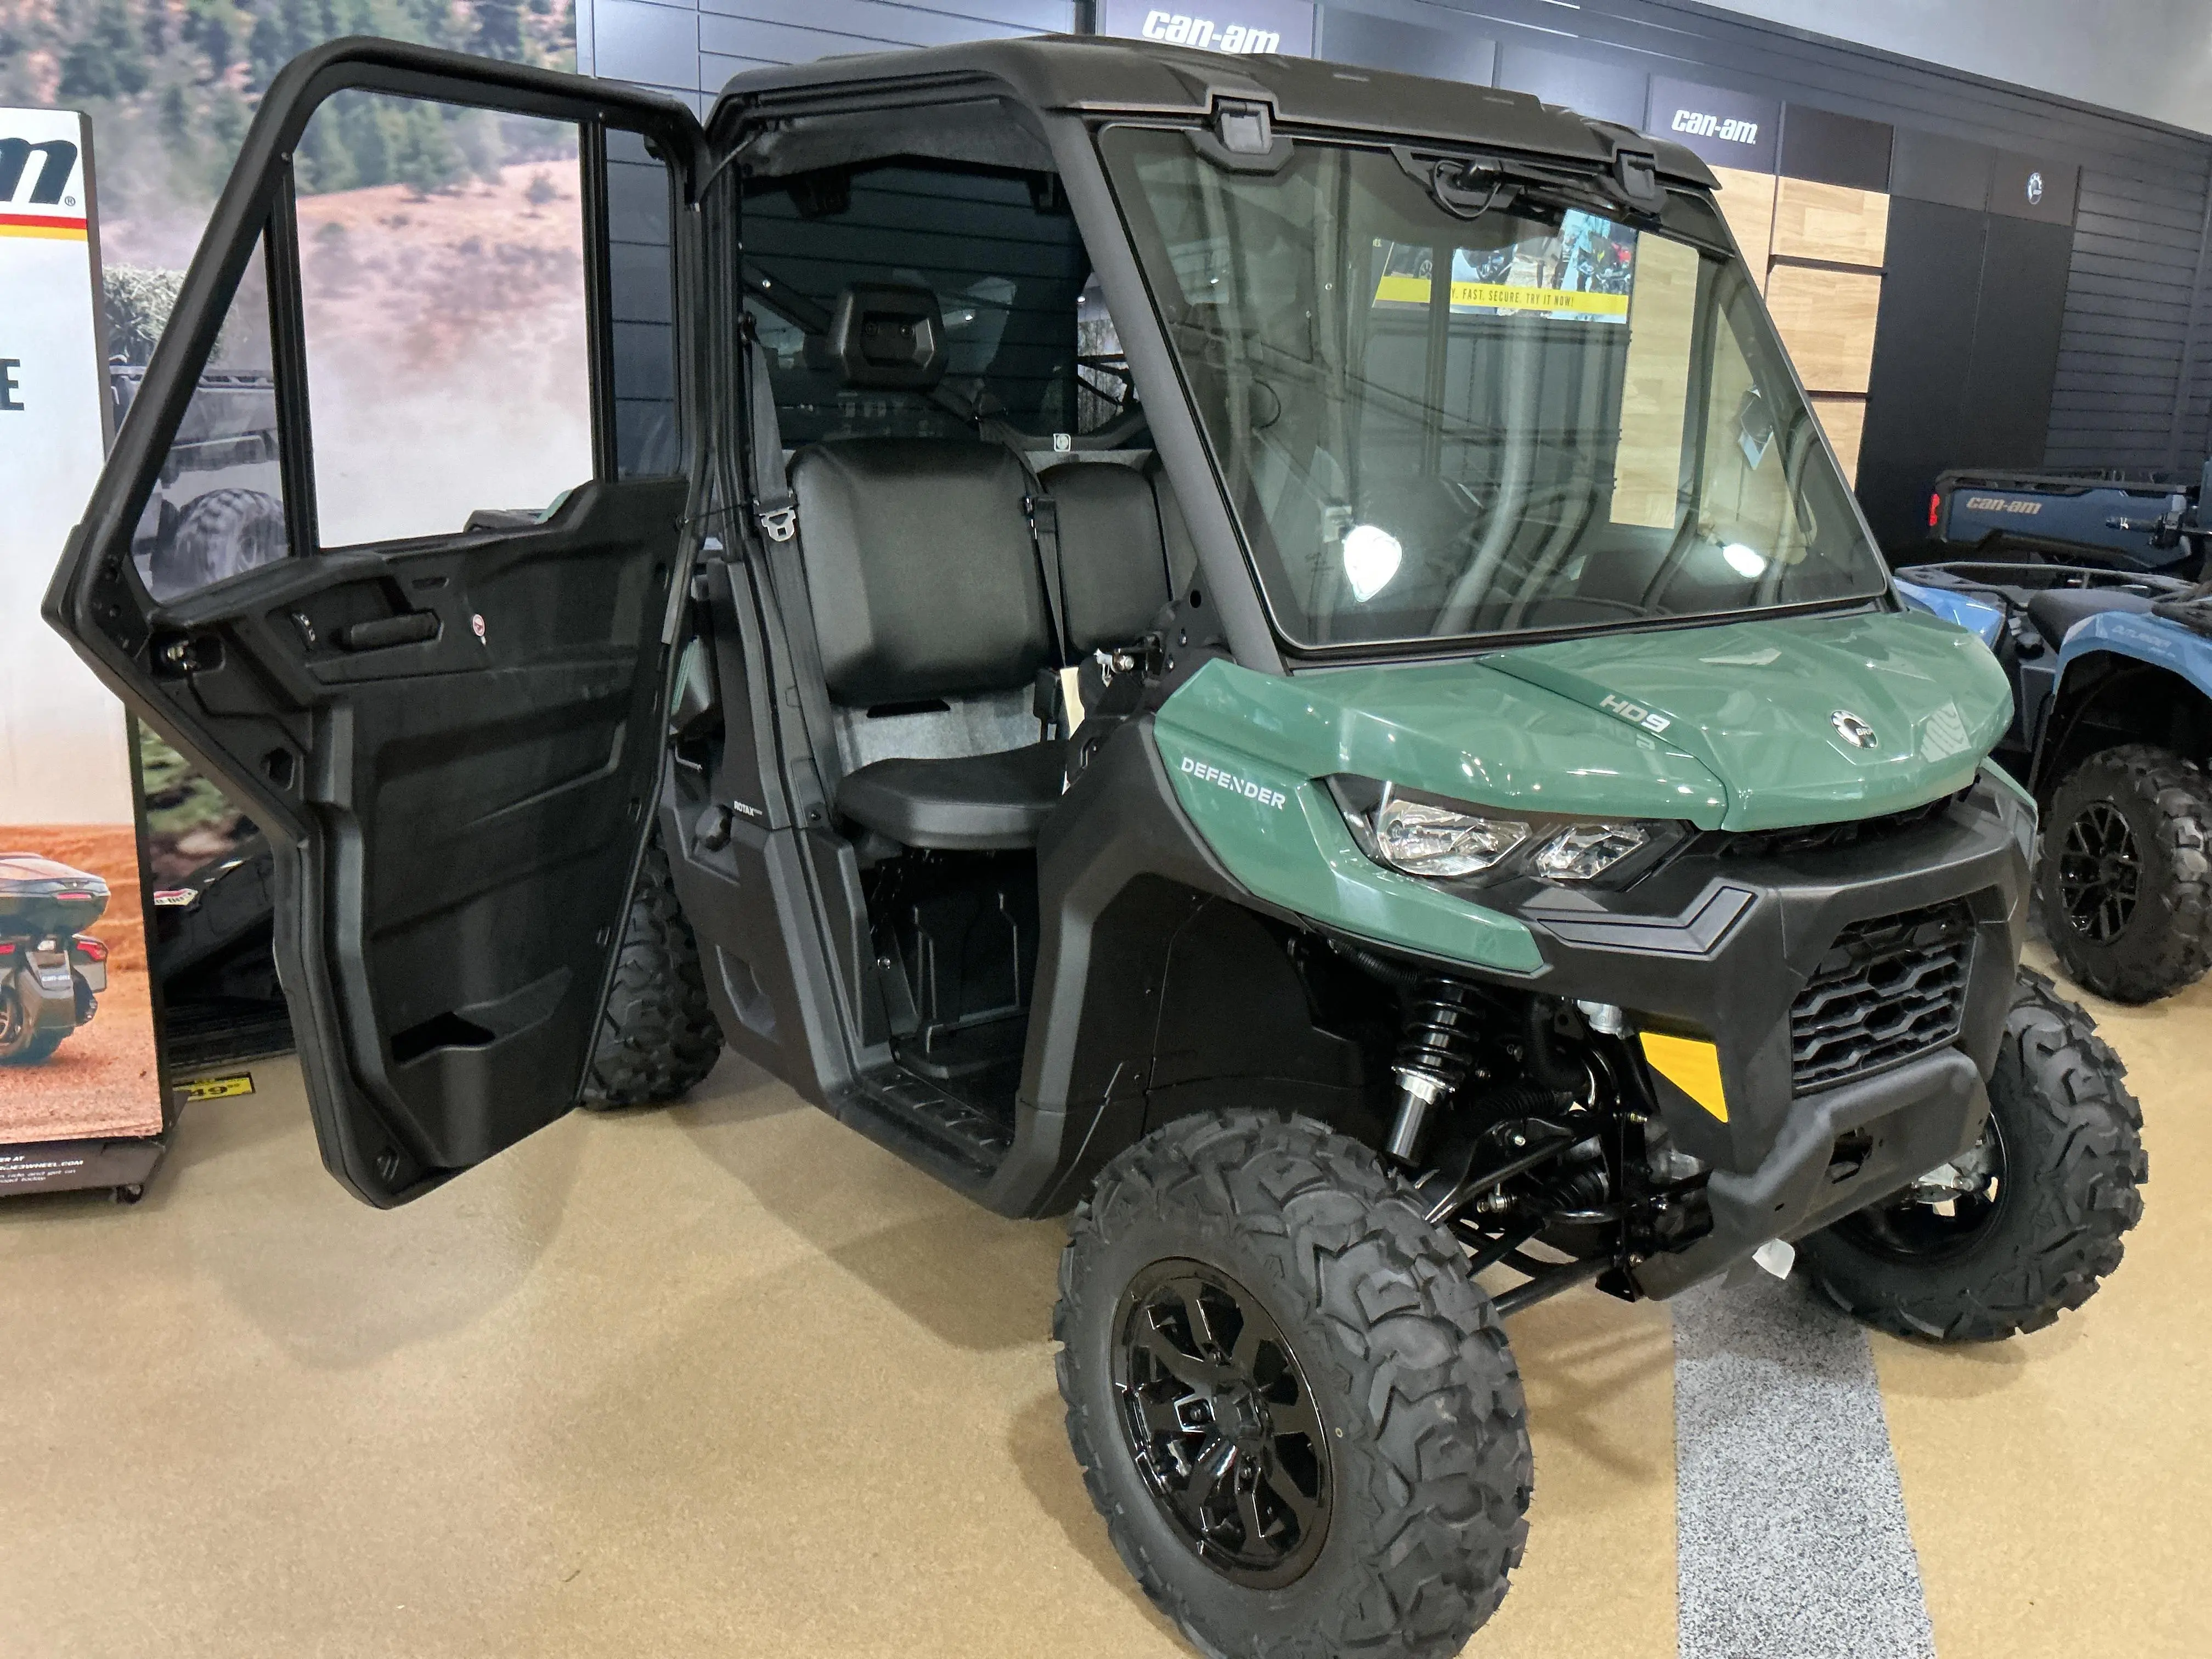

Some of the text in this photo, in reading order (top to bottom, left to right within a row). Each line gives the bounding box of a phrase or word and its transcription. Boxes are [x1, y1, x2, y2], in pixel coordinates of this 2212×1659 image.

[1142, 10, 1280, 54] can-am
[1671, 110, 1758, 144] can-am
[1463, 289, 1485, 301] FAST.
[1526, 293, 1539, 305] TRY
[1543, 294, 1551, 305] IT
[1554, 295, 1574, 307] NOW!
[1966, 497, 2042, 515] can-am
[1599, 694, 1671, 733] HD9
[1181, 757, 1286, 810] DEFENDER
[734, 800, 754, 817] ROTAX
